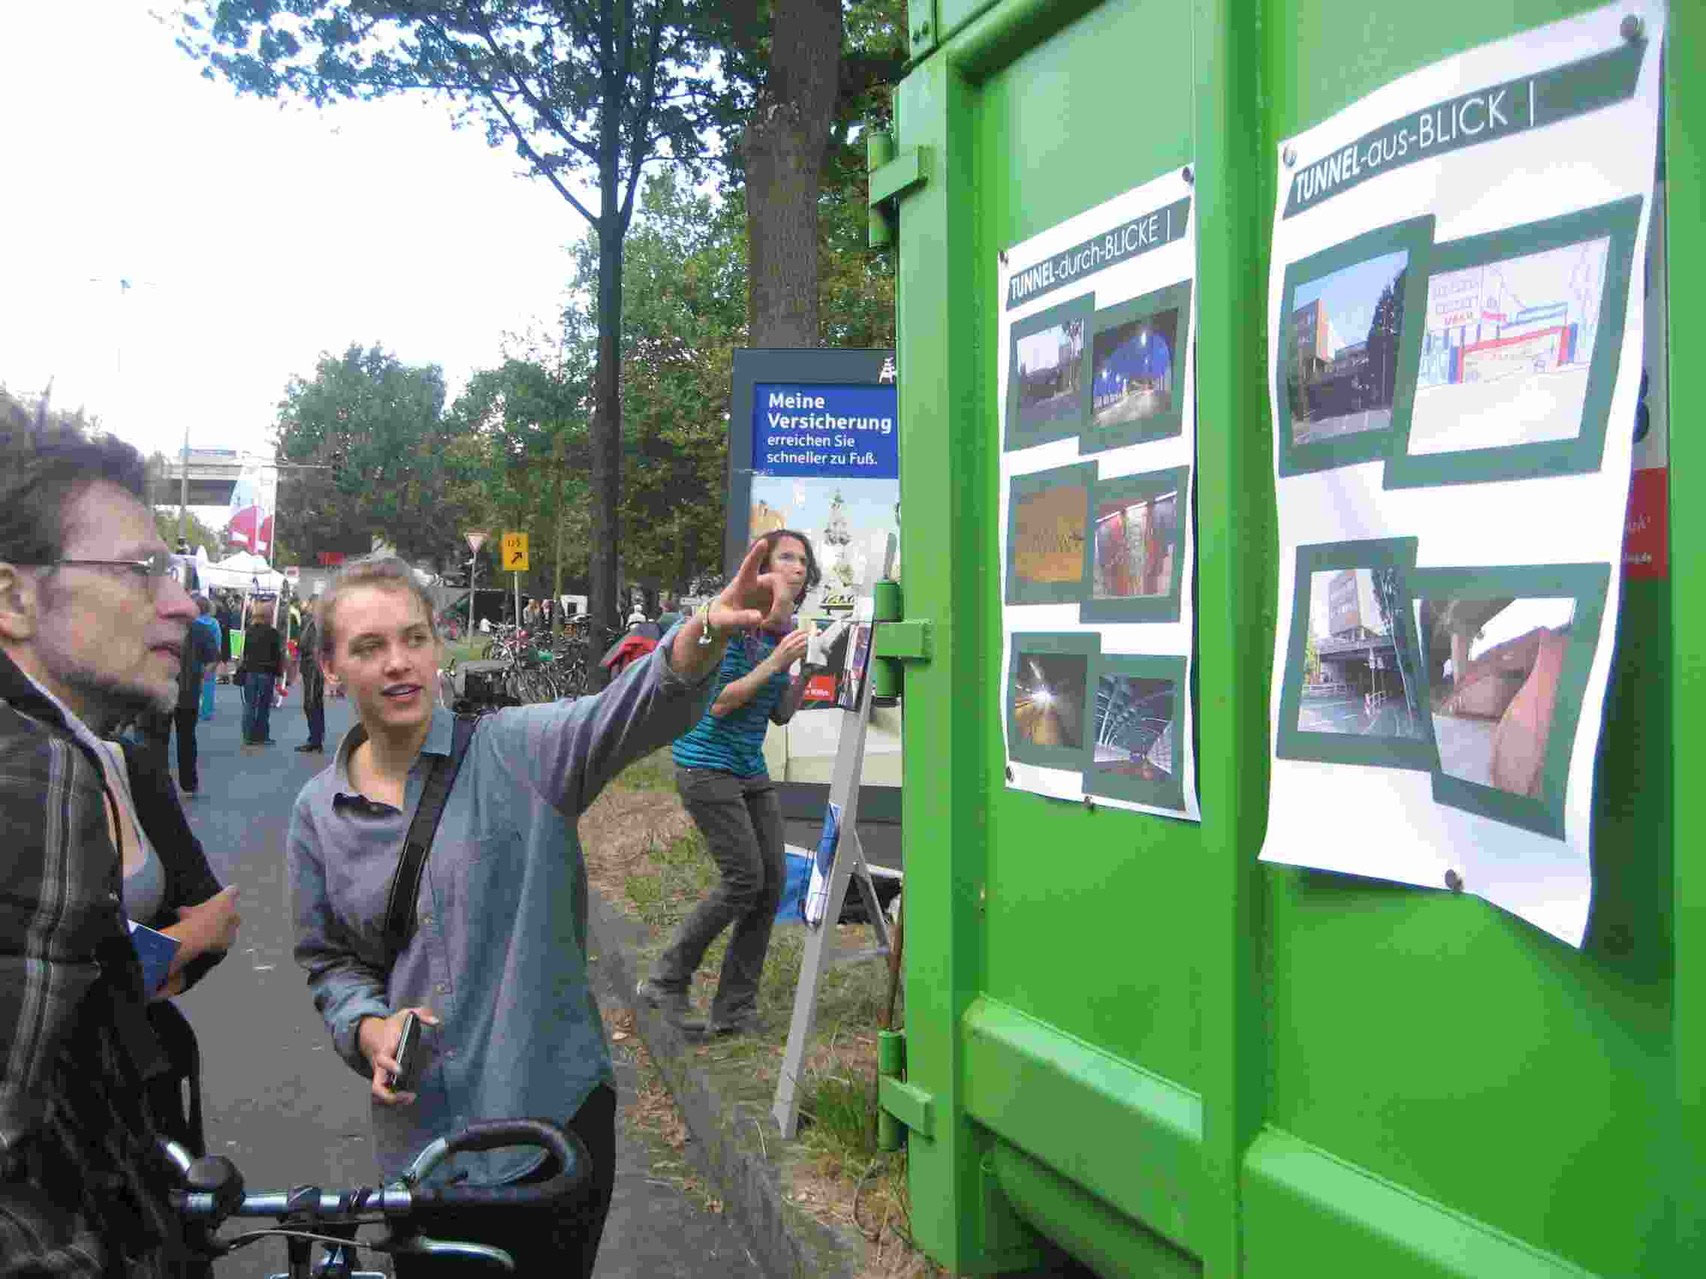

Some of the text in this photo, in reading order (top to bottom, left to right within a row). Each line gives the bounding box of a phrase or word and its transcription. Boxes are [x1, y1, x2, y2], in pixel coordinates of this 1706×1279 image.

[1295, 89, 1509, 203] TUNNEL-aus-BLICK
[1011, 215, 1159, 300] TUNNEL-durch-BLICKE
[768, 392, 826, 409] Meine
[767, 412, 893, 434] Versicherung
[767, 433, 855, 448] erreichen Sie
[766, 450, 878, 465] schneller zu Fuß.
